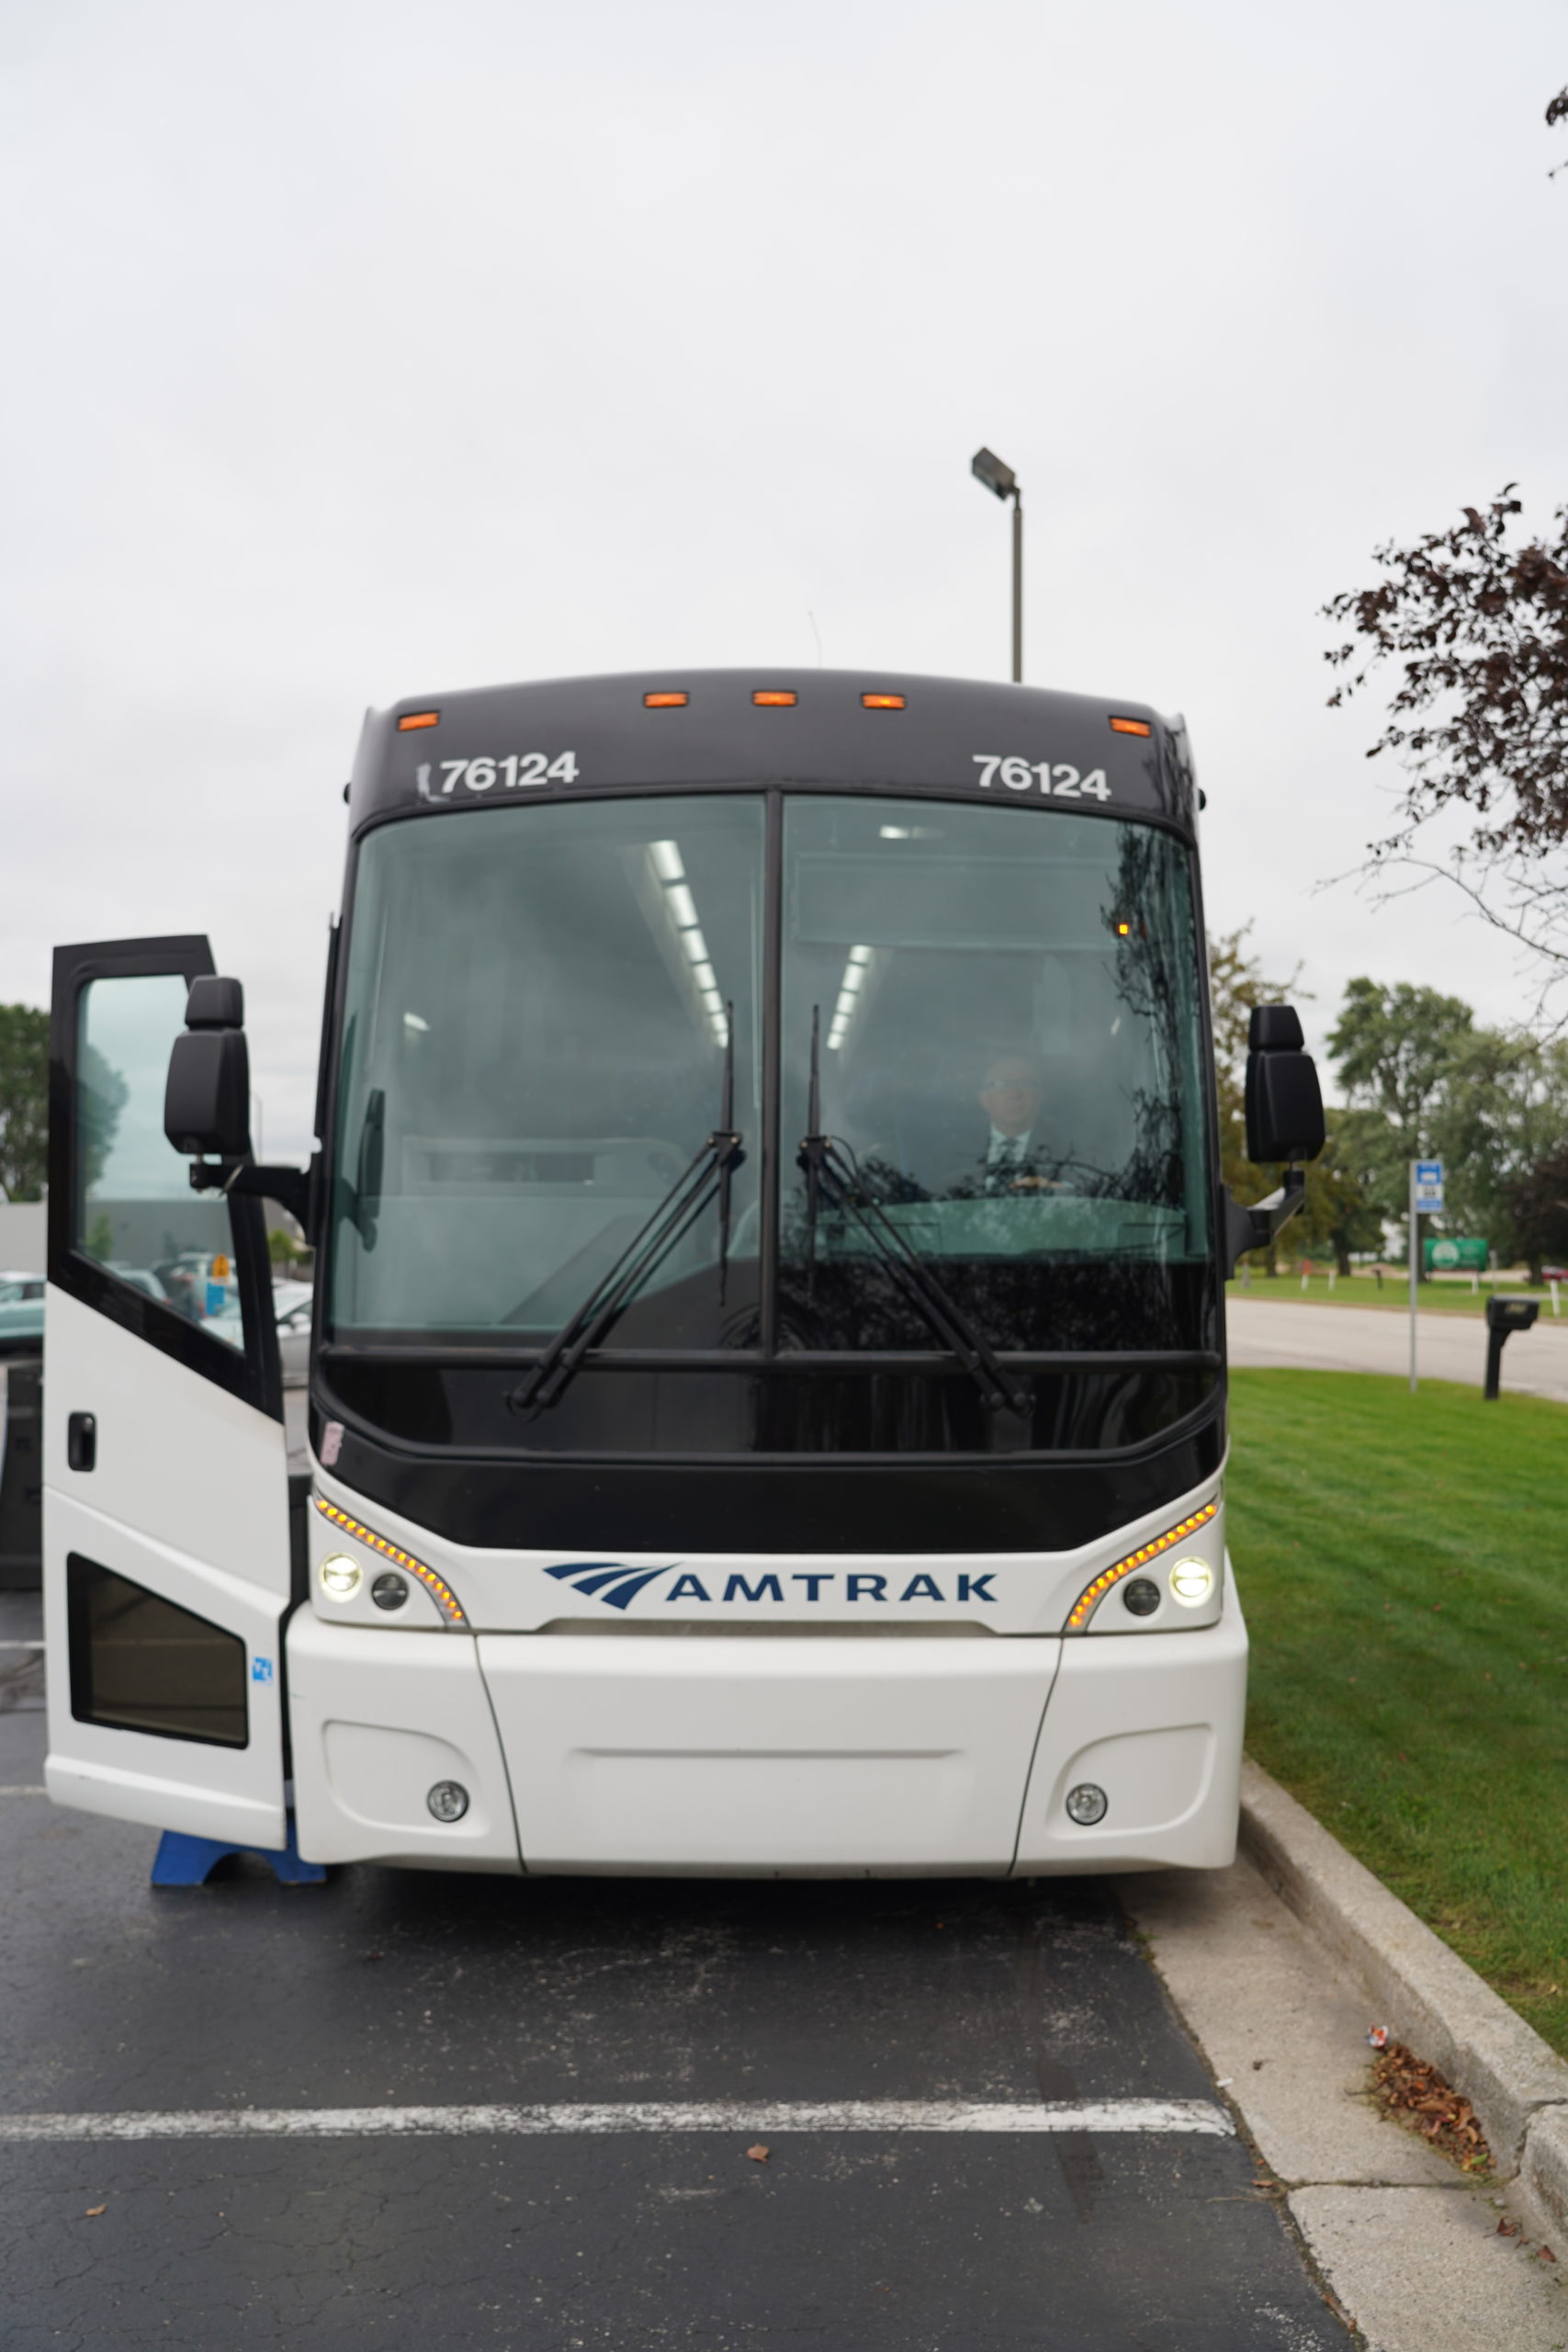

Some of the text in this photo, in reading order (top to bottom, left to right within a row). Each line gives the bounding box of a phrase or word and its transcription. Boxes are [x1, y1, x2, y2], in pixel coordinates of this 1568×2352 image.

[439, 750, 580, 794] 76124
[972, 754, 1112, 802] 76124
[664, 1574, 998, 1602] AMTRAK
